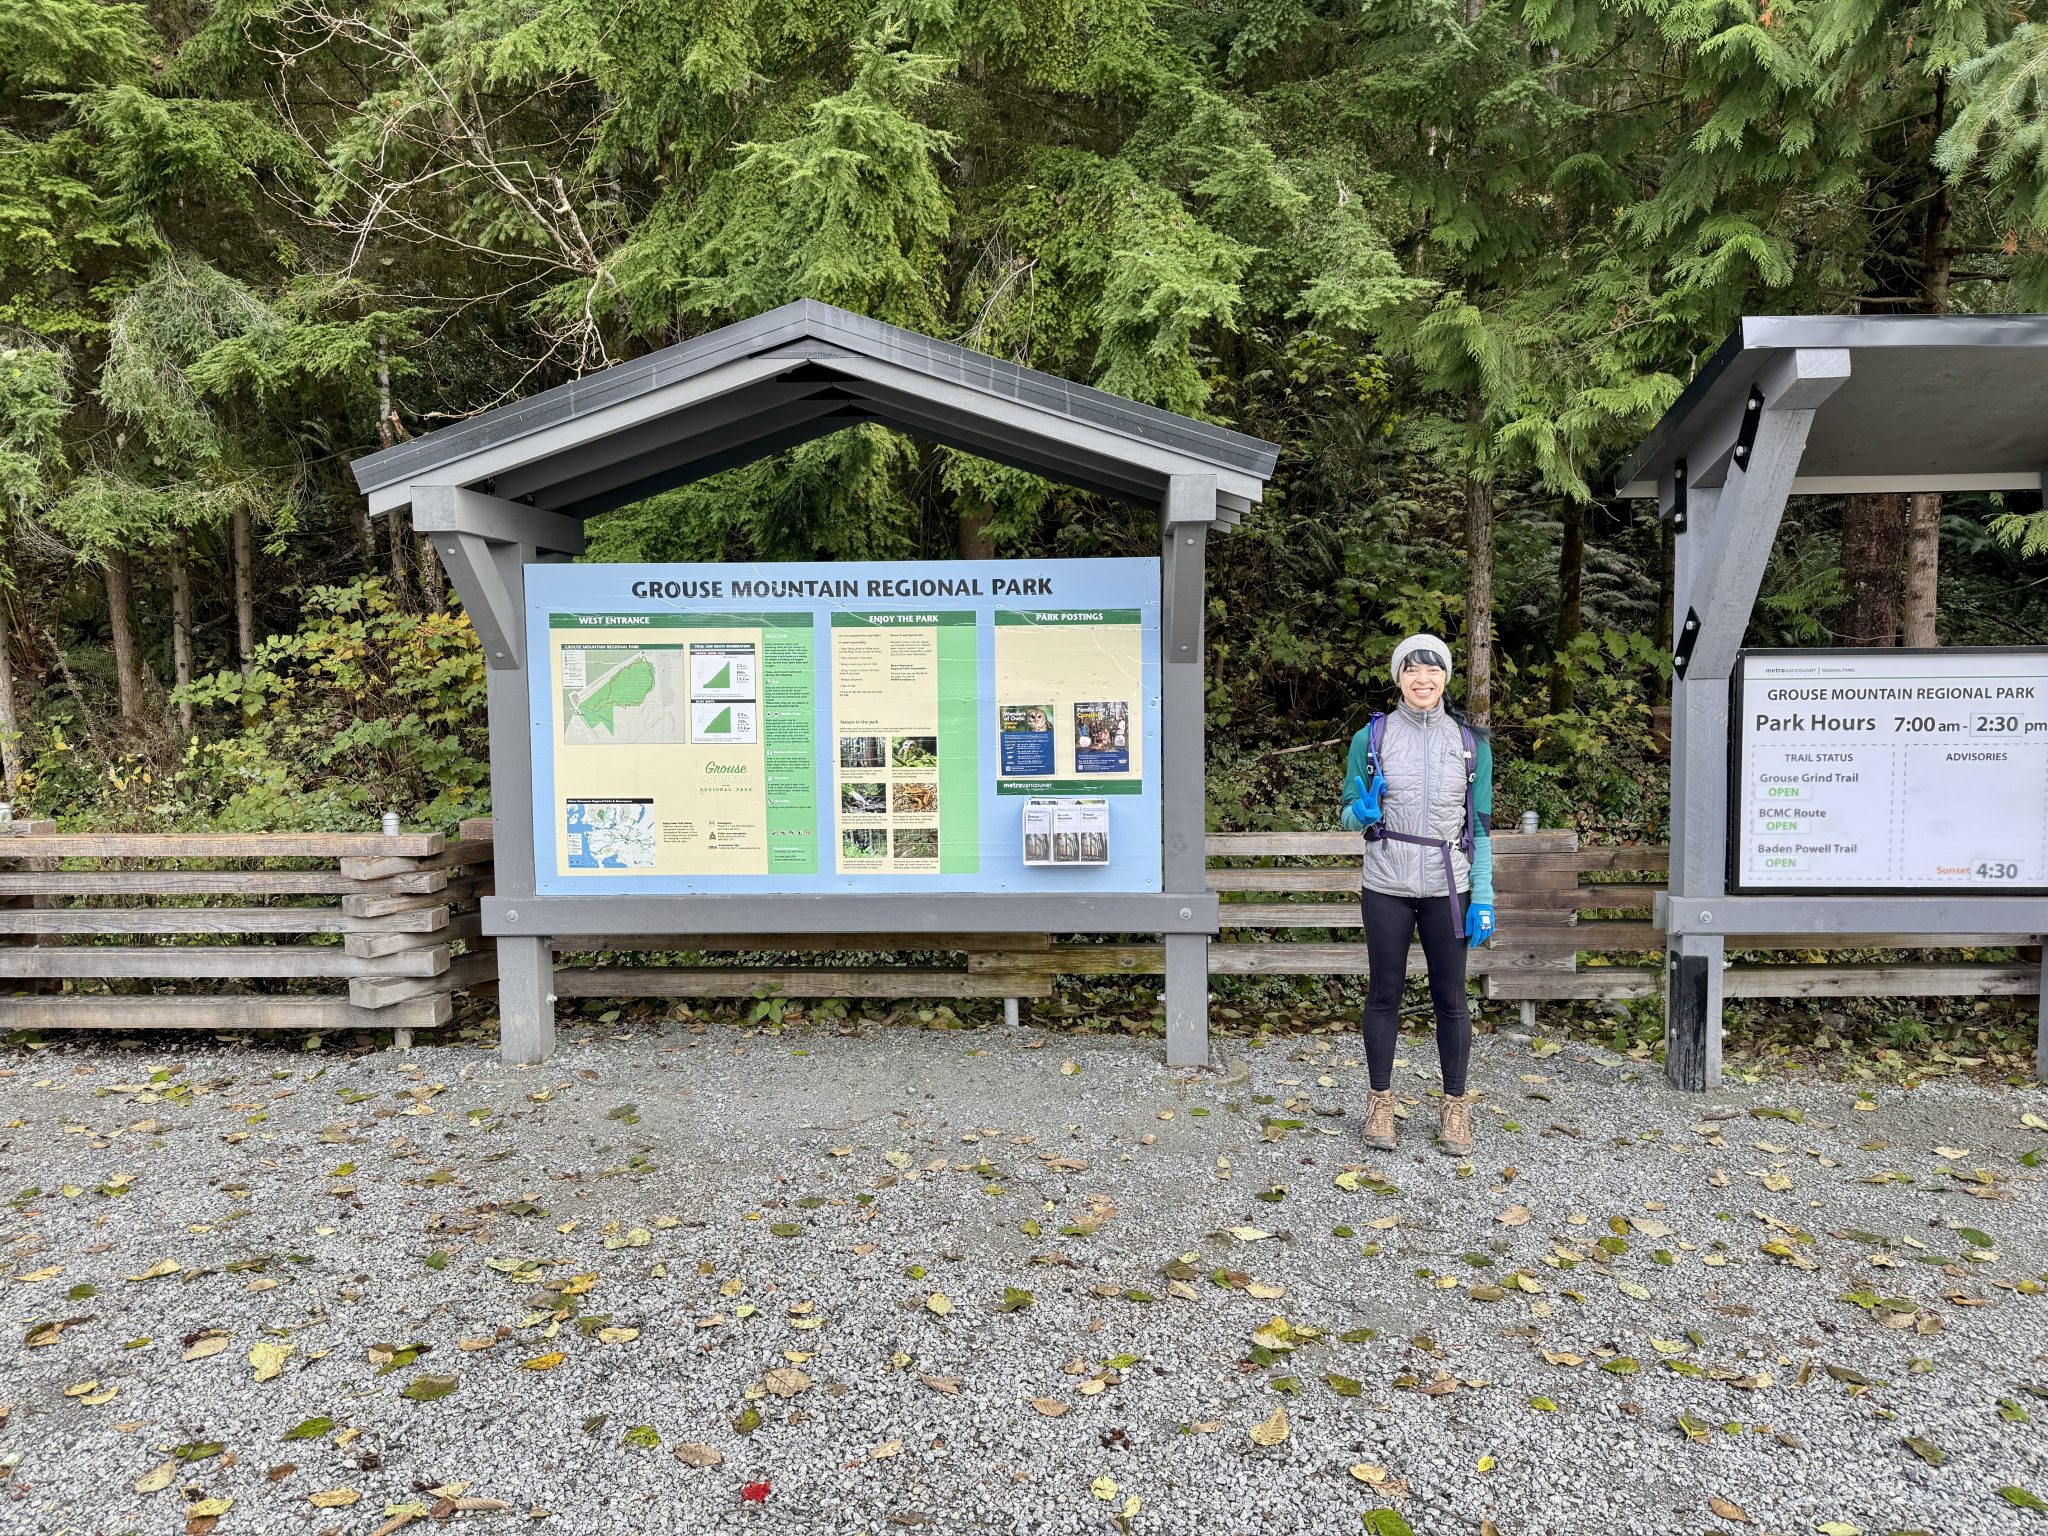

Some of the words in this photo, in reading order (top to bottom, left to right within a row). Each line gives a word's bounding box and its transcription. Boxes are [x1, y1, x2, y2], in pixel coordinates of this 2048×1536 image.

[632, 581, 723, 598] GROUSE
[732, 580, 858, 598] MOUNTAIN
[867, 579, 983, 597] REGIONAL
[992, 578, 1053, 595] PARK
[579, 616, 603, 624] WEST
[606, 616, 650, 624] ENTRANCE
[1036, 613, 1059, 621] PARK
[1768, 689, 1827, 700] GROUSE
[1832, 689, 1912, 699] MOUNTAIN
[1917, 688, 1992, 699] REGIONAL
[1997, 687, 2034, 698] PARK
[1757, 714, 1804, 731] Park
[1812, 714, 1875, 730] Hours
[1895, 717, 1935, 732] 7:00
[1939, 723, 1960, 731] am
[1977, 717, 2018, 731] 2:30
[2025, 723, 2047, 734] pm
[1785, 754, 1814, 762] TRAIL
[1818, 754, 1853, 762] STATUS
[1946, 753, 2007, 761] ADVISORIES
[705, 761, 748, 774] Grouse
[1760, 774, 1799, 782] Grouse
[1802, 773, 1832, 782] Grind
[1835, 773, 1858, 782] Trail
[1769, 788, 1799, 796] OPEN
[1760, 809, 1791, 817] BCMC
[1794, 809, 1826, 817] Route
[1767, 822, 1796, 830] OPEN
[1758, 844, 1792, 853] Baden
[1796, 844, 1831, 853] Powell
[1834, 844, 1857, 853] Trail
[1766, 859, 1796, 867] OPEN
[1936, 866, 1971, 875] Sunset
[1976, 864, 2017, 879] 4:30
